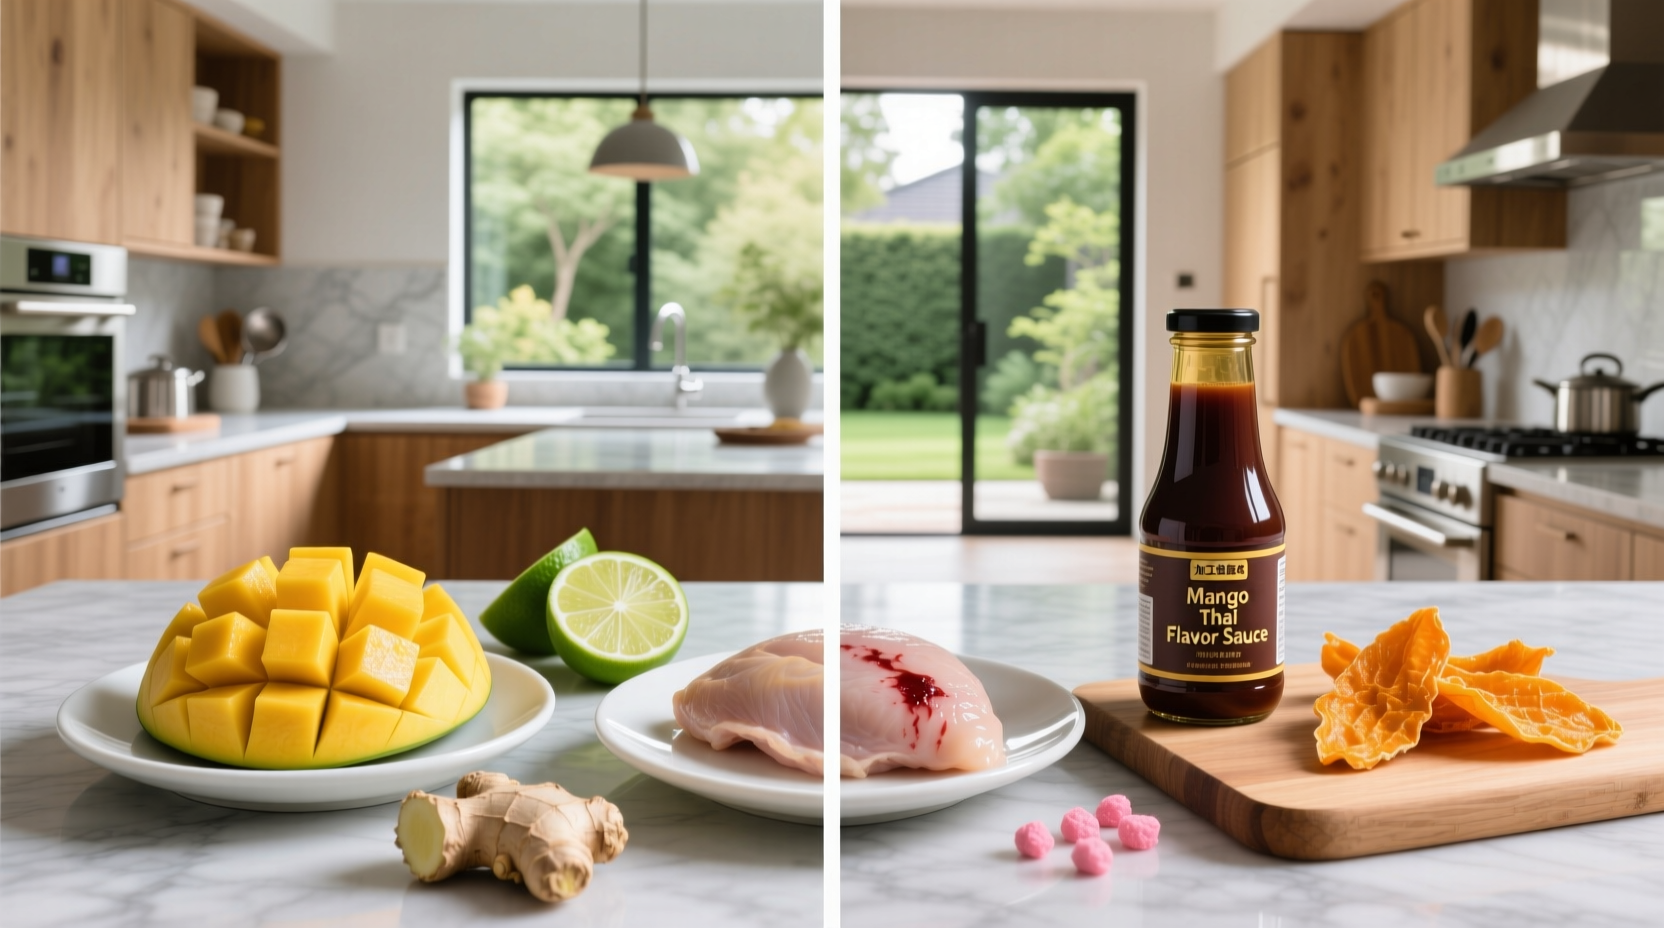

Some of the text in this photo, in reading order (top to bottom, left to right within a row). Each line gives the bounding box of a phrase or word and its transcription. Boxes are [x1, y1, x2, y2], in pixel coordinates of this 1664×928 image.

[1187, 587, 1249, 609] Mango
[1167, 625, 1269, 645] Flavor Sauce
